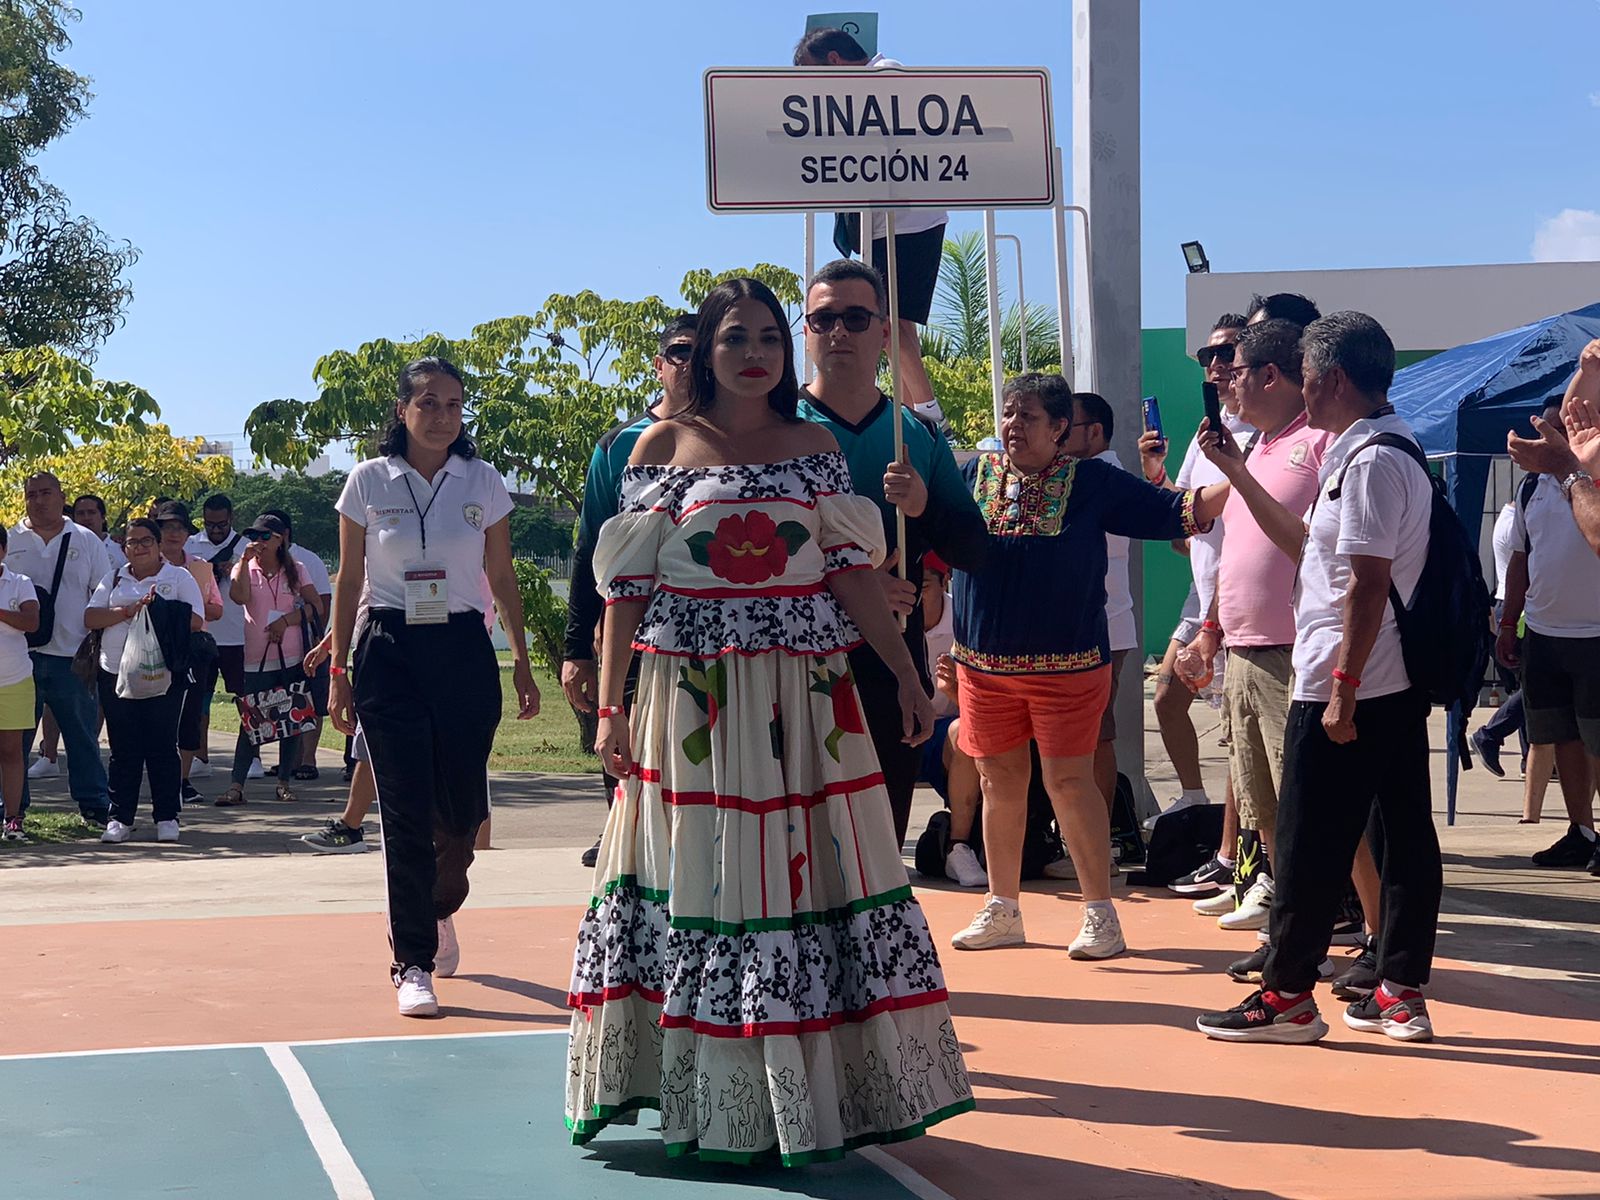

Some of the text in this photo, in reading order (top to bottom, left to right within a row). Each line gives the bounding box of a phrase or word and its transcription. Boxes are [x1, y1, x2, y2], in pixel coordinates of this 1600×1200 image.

[782, 94, 984, 138] SINALOA
[801, 148, 969, 184] SECCIÓN 24
